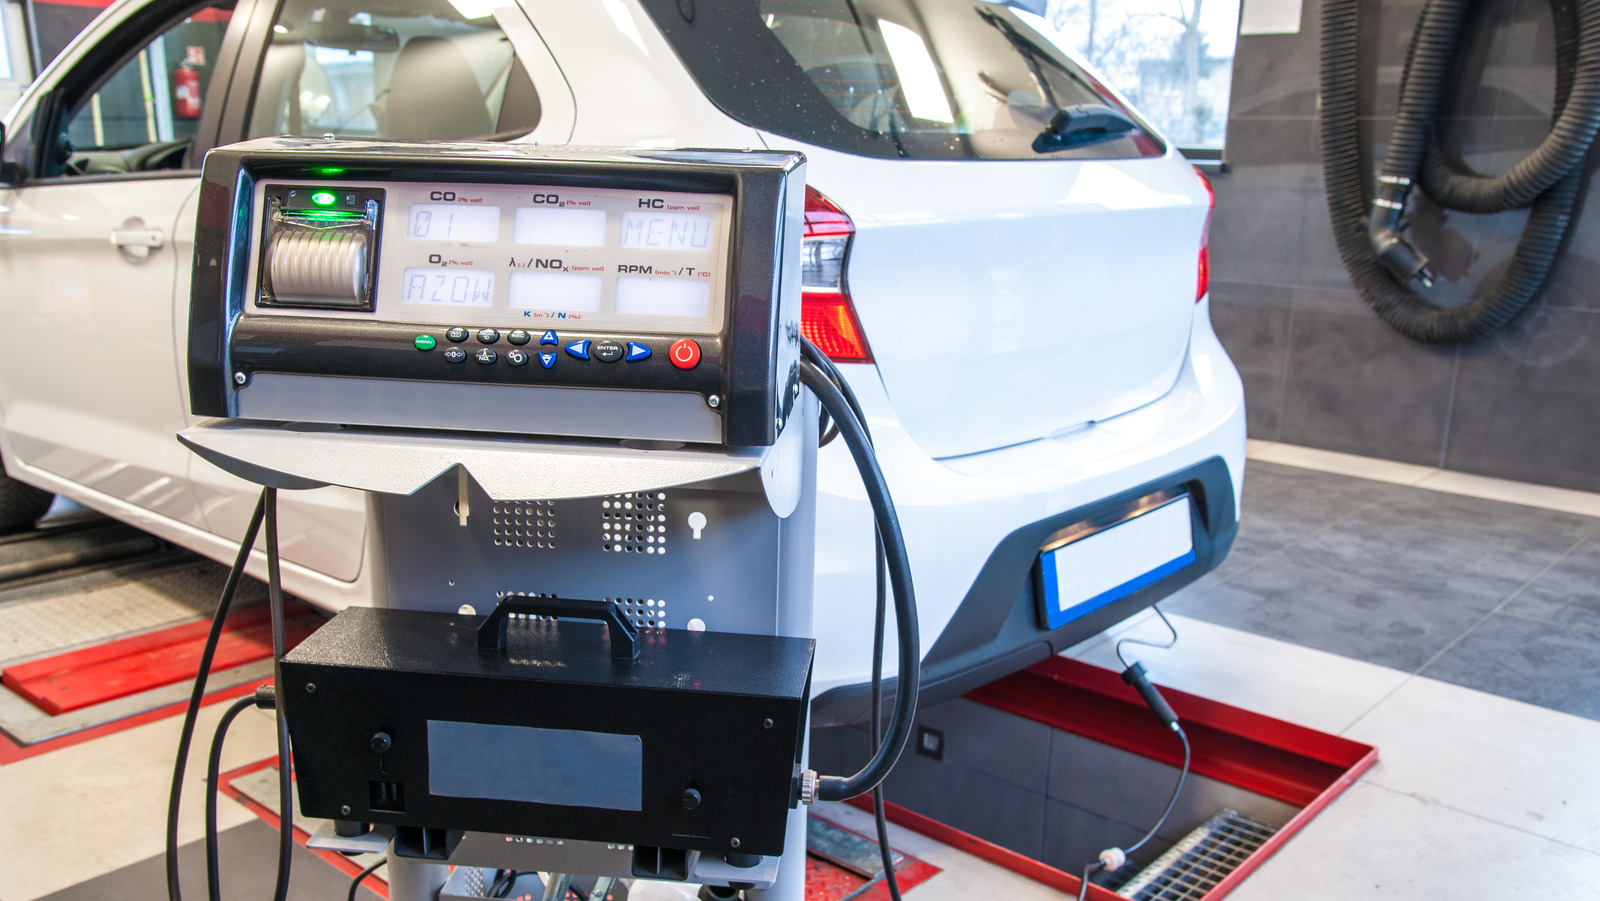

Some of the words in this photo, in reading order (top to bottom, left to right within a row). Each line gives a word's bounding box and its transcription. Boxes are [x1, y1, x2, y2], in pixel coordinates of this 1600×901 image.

[430, 191, 456, 202] CO
[638, 198, 664, 209] HC
[624, 219, 711, 248] MENU
[618, 264, 652, 274] RPM
